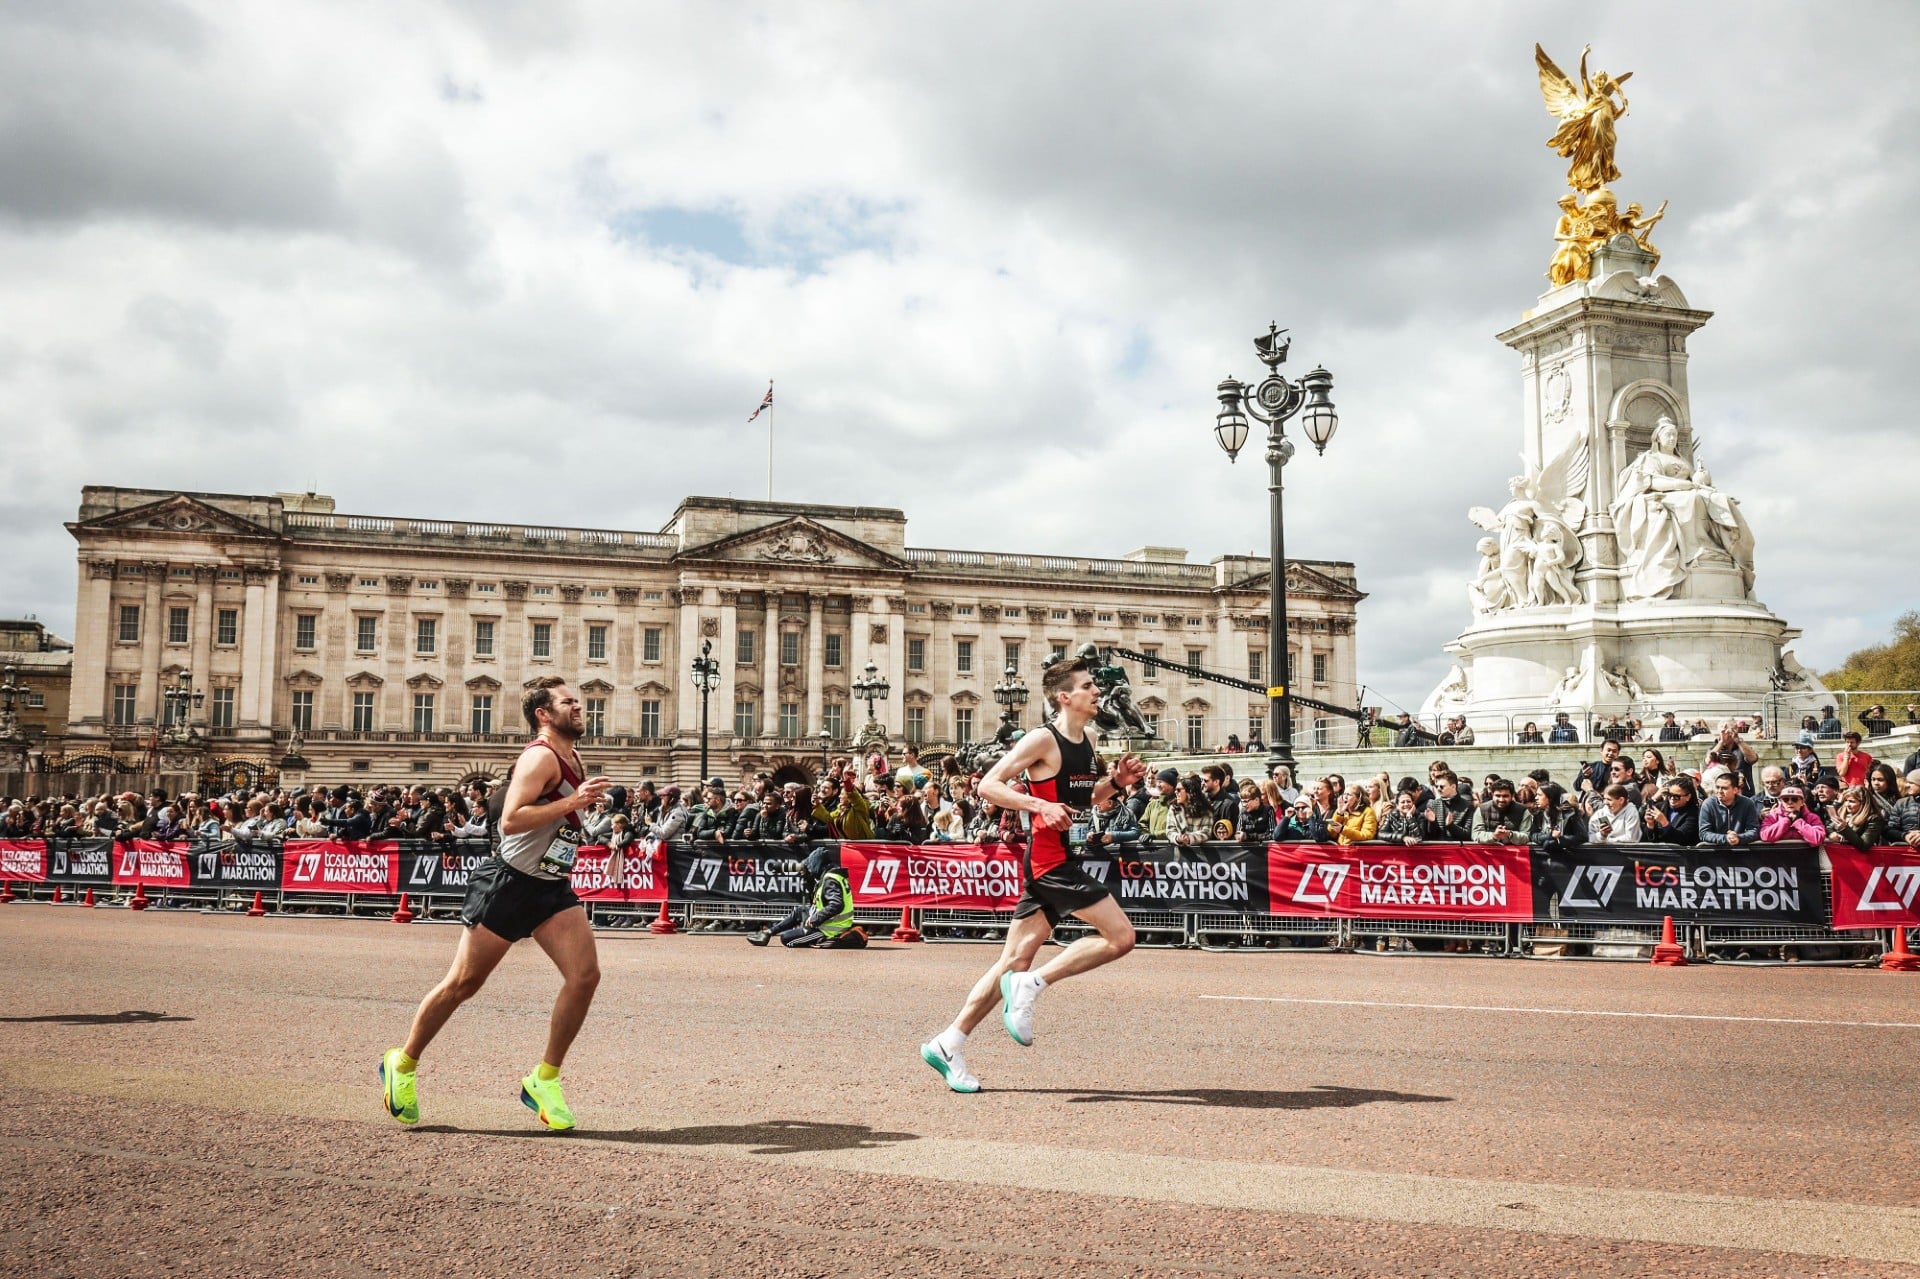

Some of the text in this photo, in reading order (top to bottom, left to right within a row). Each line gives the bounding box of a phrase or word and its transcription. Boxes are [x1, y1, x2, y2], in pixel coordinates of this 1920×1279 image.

[72, 863, 109, 876] MARATHON
[140, 863, 183, 878] MARATHON
[222, 866, 276, 880] MARATHON
[324, 868, 388, 884] MARATHON
[909, 876, 1019, 897] MARATHON
[1122, 880, 1248, 900] MARATHON
[1360, 884, 1507, 907] MARATHON
[1636, 887, 1800, 911] MARATHON
